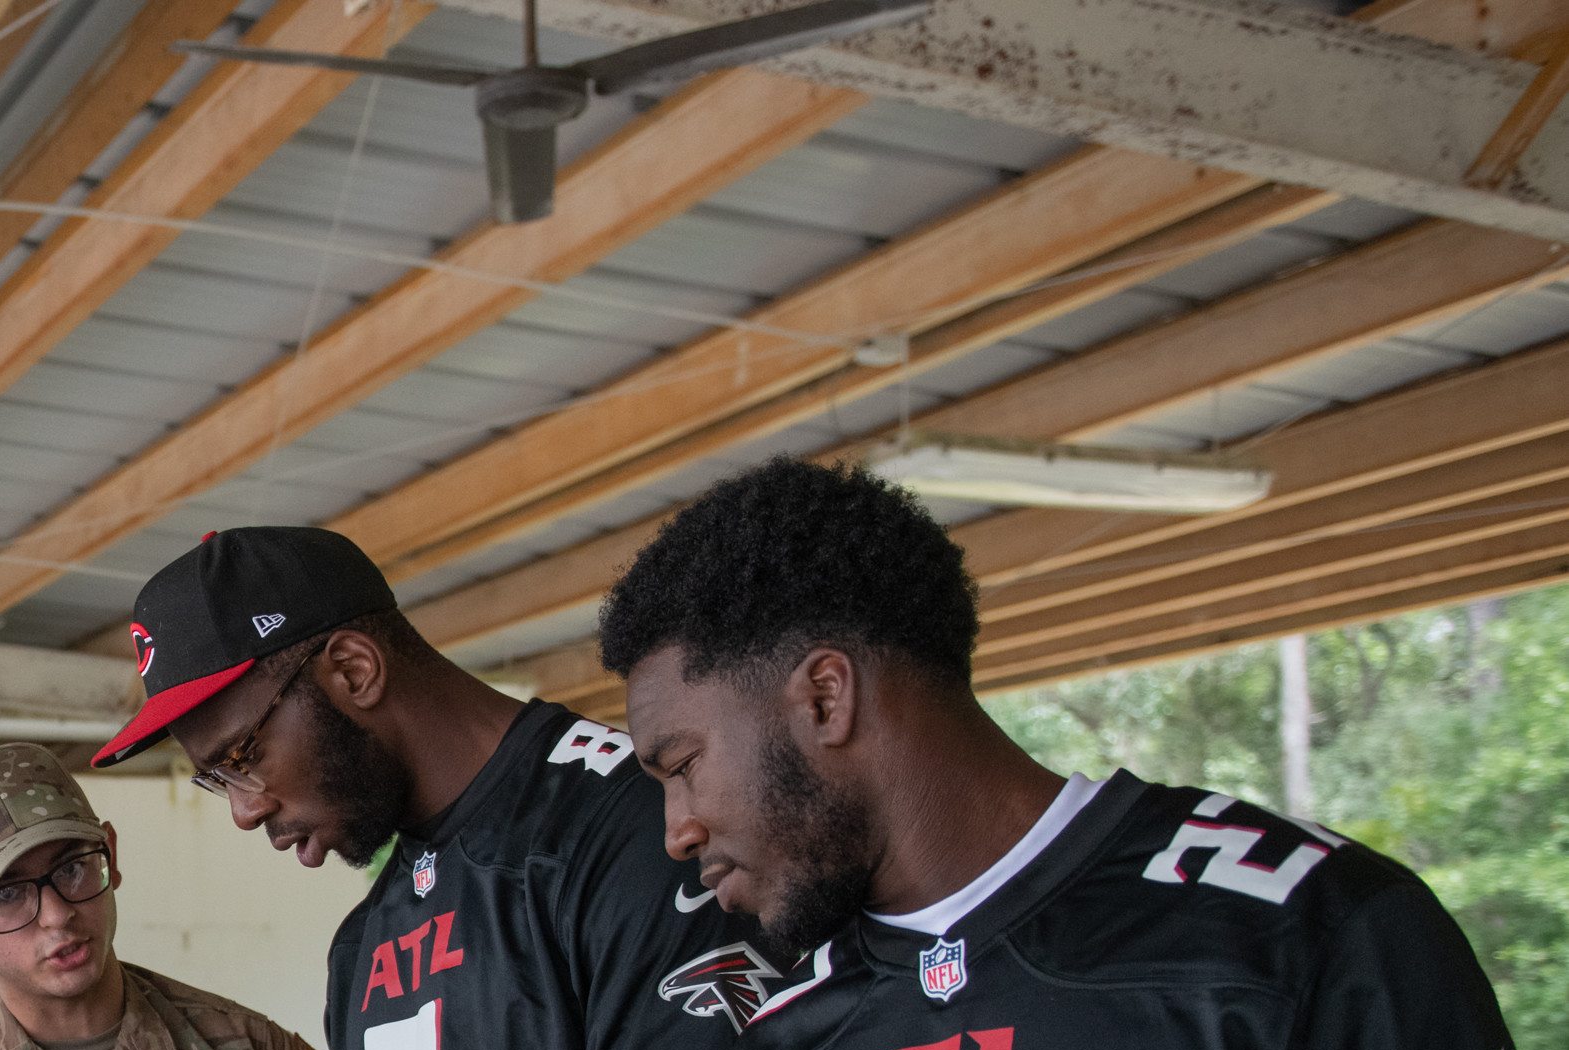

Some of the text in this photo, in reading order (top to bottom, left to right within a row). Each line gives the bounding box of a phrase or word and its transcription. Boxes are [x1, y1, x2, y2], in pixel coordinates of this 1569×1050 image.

[547, 719, 634, 776] 8
[415, 869, 431, 889] NFL
[361, 910, 464, 1013] ATL
[926, 962, 959, 990] NFL
